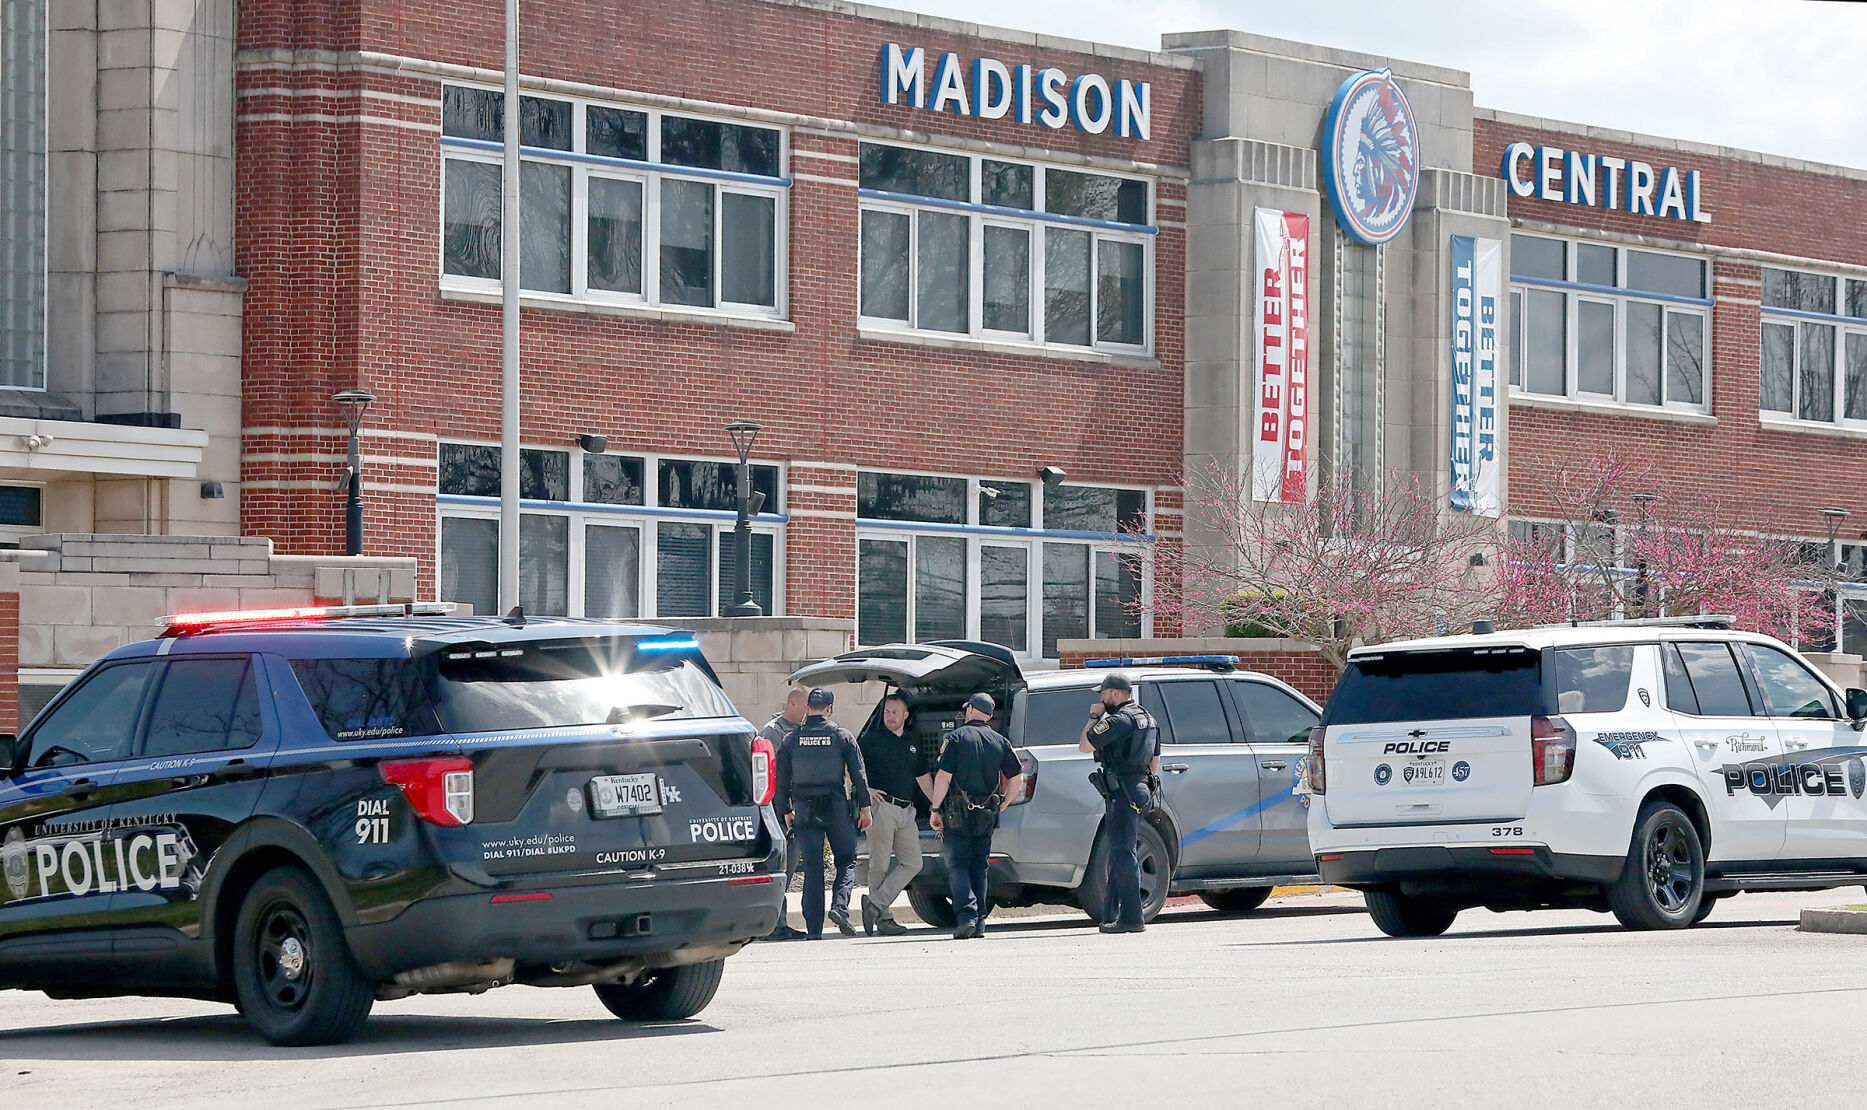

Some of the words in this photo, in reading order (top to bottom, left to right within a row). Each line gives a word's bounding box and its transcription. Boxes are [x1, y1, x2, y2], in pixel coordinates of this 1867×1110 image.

[881, 43, 1150, 140] MADISON
[1502, 142, 1712, 223] CENTRAL
[1260, 267, 1282, 442] BETTER
[1286, 236, 1306, 479] TOGETHER
[1455, 259, 1472, 492] TOGETHER
[1479, 295, 1496, 462] BETTER
[337, 726, 404, 738] www.uky.edu/police
[1597, 732, 1659, 742] EMERGENCY
[1384, 741, 1451, 754] POLICE
[1620, 743, 1648, 760] 911
[149, 760, 182, 770] CAUTION
[1294, 756, 1308, 779] KENT
[1415, 767, 1442, 779] A9L612
[1453, 766, 1469, 777] 457
[611, 776, 639, 784] Kentucky
[1722, 763, 1848, 797] POLICE
[615, 784, 653, 803] W7402
[356, 800, 390, 816] DIAL
[35, 820, 98, 836] UNIVERSITY
[101, 819, 115, 830] OF
[119, 813, 178, 828] KENTUCKY
[355, 818, 390, 844] 911
[690, 820, 756, 843] POLICE
[1492, 827, 1523, 836] 378
[482, 833, 575, 848] www.uky.edu/police
[483, 850, 505, 860] DIAL
[506, 848, 545, 858] 911/DIAL
[596, 850, 646, 864] CAUTION
[648, 849, 666, 860] K-9
[36, 833, 180, 896] POLICE
[719, 863, 746, 875] 21-038
